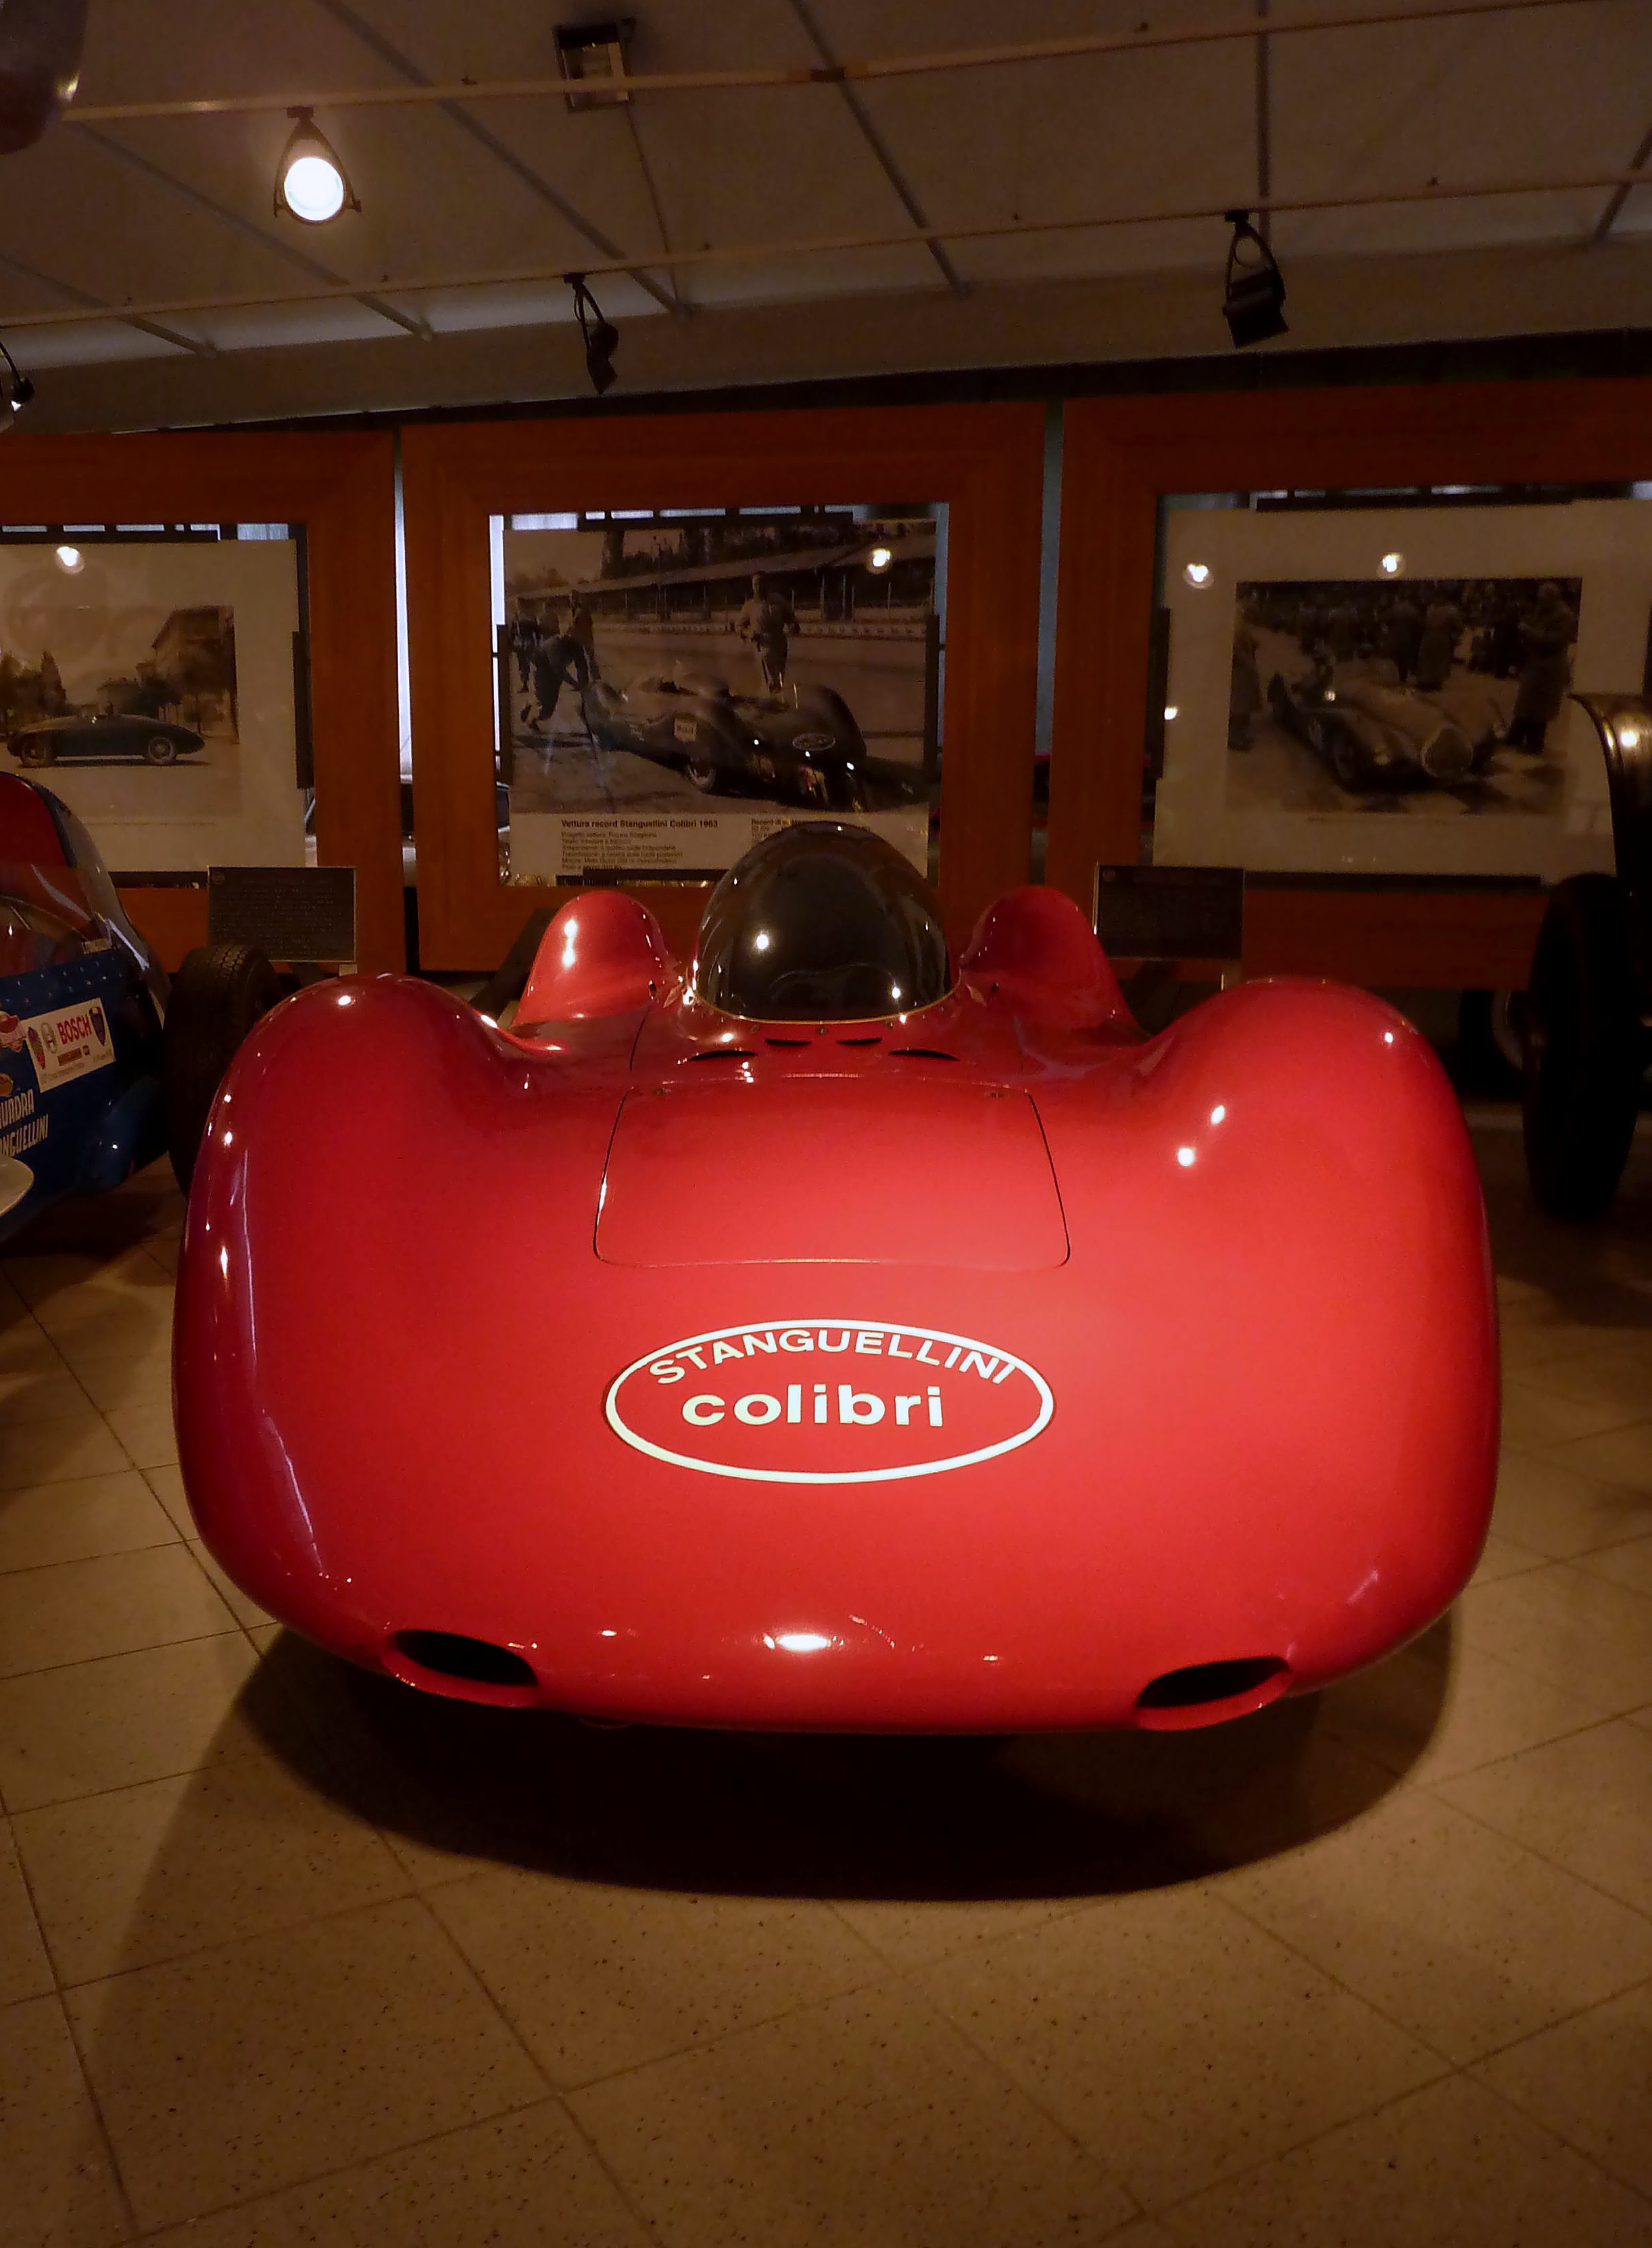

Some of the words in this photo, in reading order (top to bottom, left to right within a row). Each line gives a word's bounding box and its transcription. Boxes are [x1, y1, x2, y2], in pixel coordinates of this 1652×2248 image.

[562, 819, 590, 828] Vettura
[591, 819, 618, 828] record
[620, 819, 668, 830] Stanguellini
[669, 819, 697, 828] Colibri
[700, 819, 719, 828] 1963
[57, 1014, 92, 1045] BOSCH
[0, 1089, 35, 1130] UADRA
[649, 1329, 1018, 1385] STANGUELLINI
[682, 1384, 944, 1427] colibri
